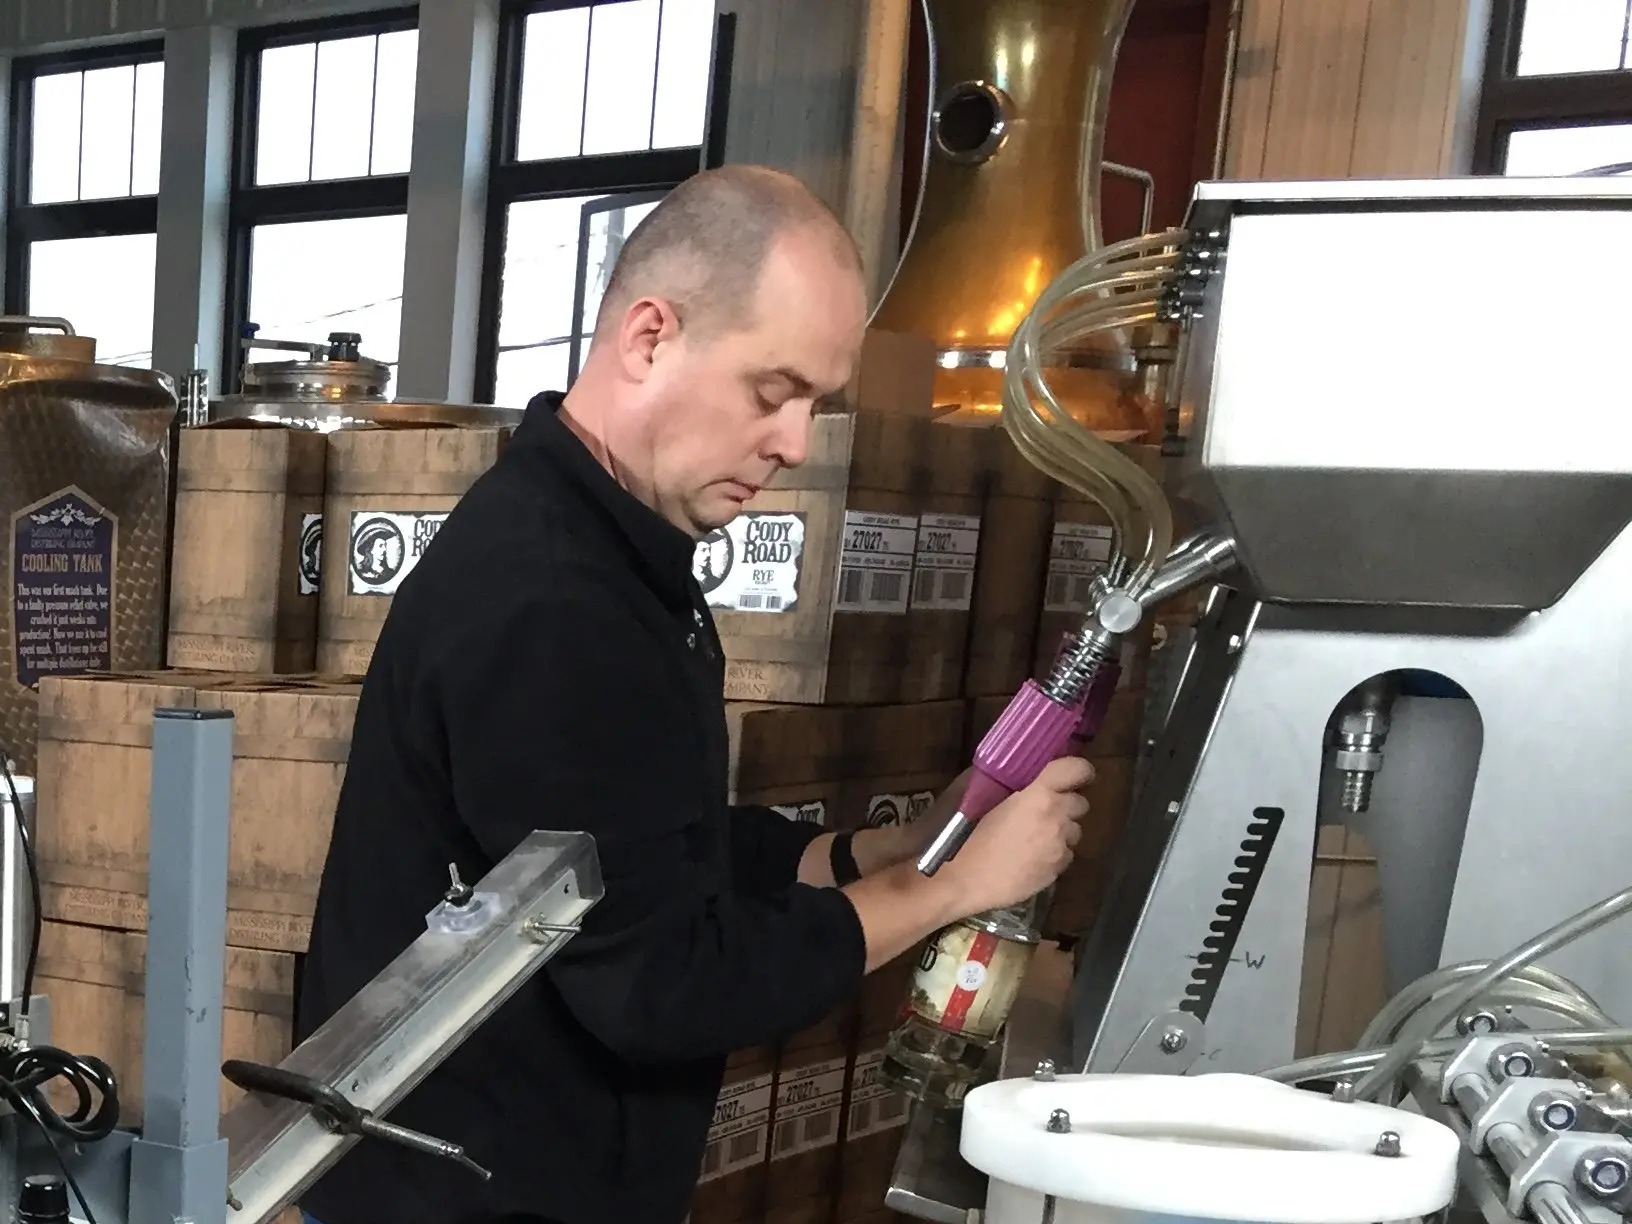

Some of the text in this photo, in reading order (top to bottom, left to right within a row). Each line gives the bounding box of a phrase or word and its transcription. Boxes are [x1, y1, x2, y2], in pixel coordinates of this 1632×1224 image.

[413, 519, 445, 538] COD
[746, 520, 794, 542] CODY
[411, 538, 432, 556] RO
[851, 529, 882, 550] 27027
[741, 541, 792, 564] ROAD
[22, 553, 103, 573] COOLING TANK
[752, 569, 775, 581] RYE
[1245, 951, 1266, 970] W
